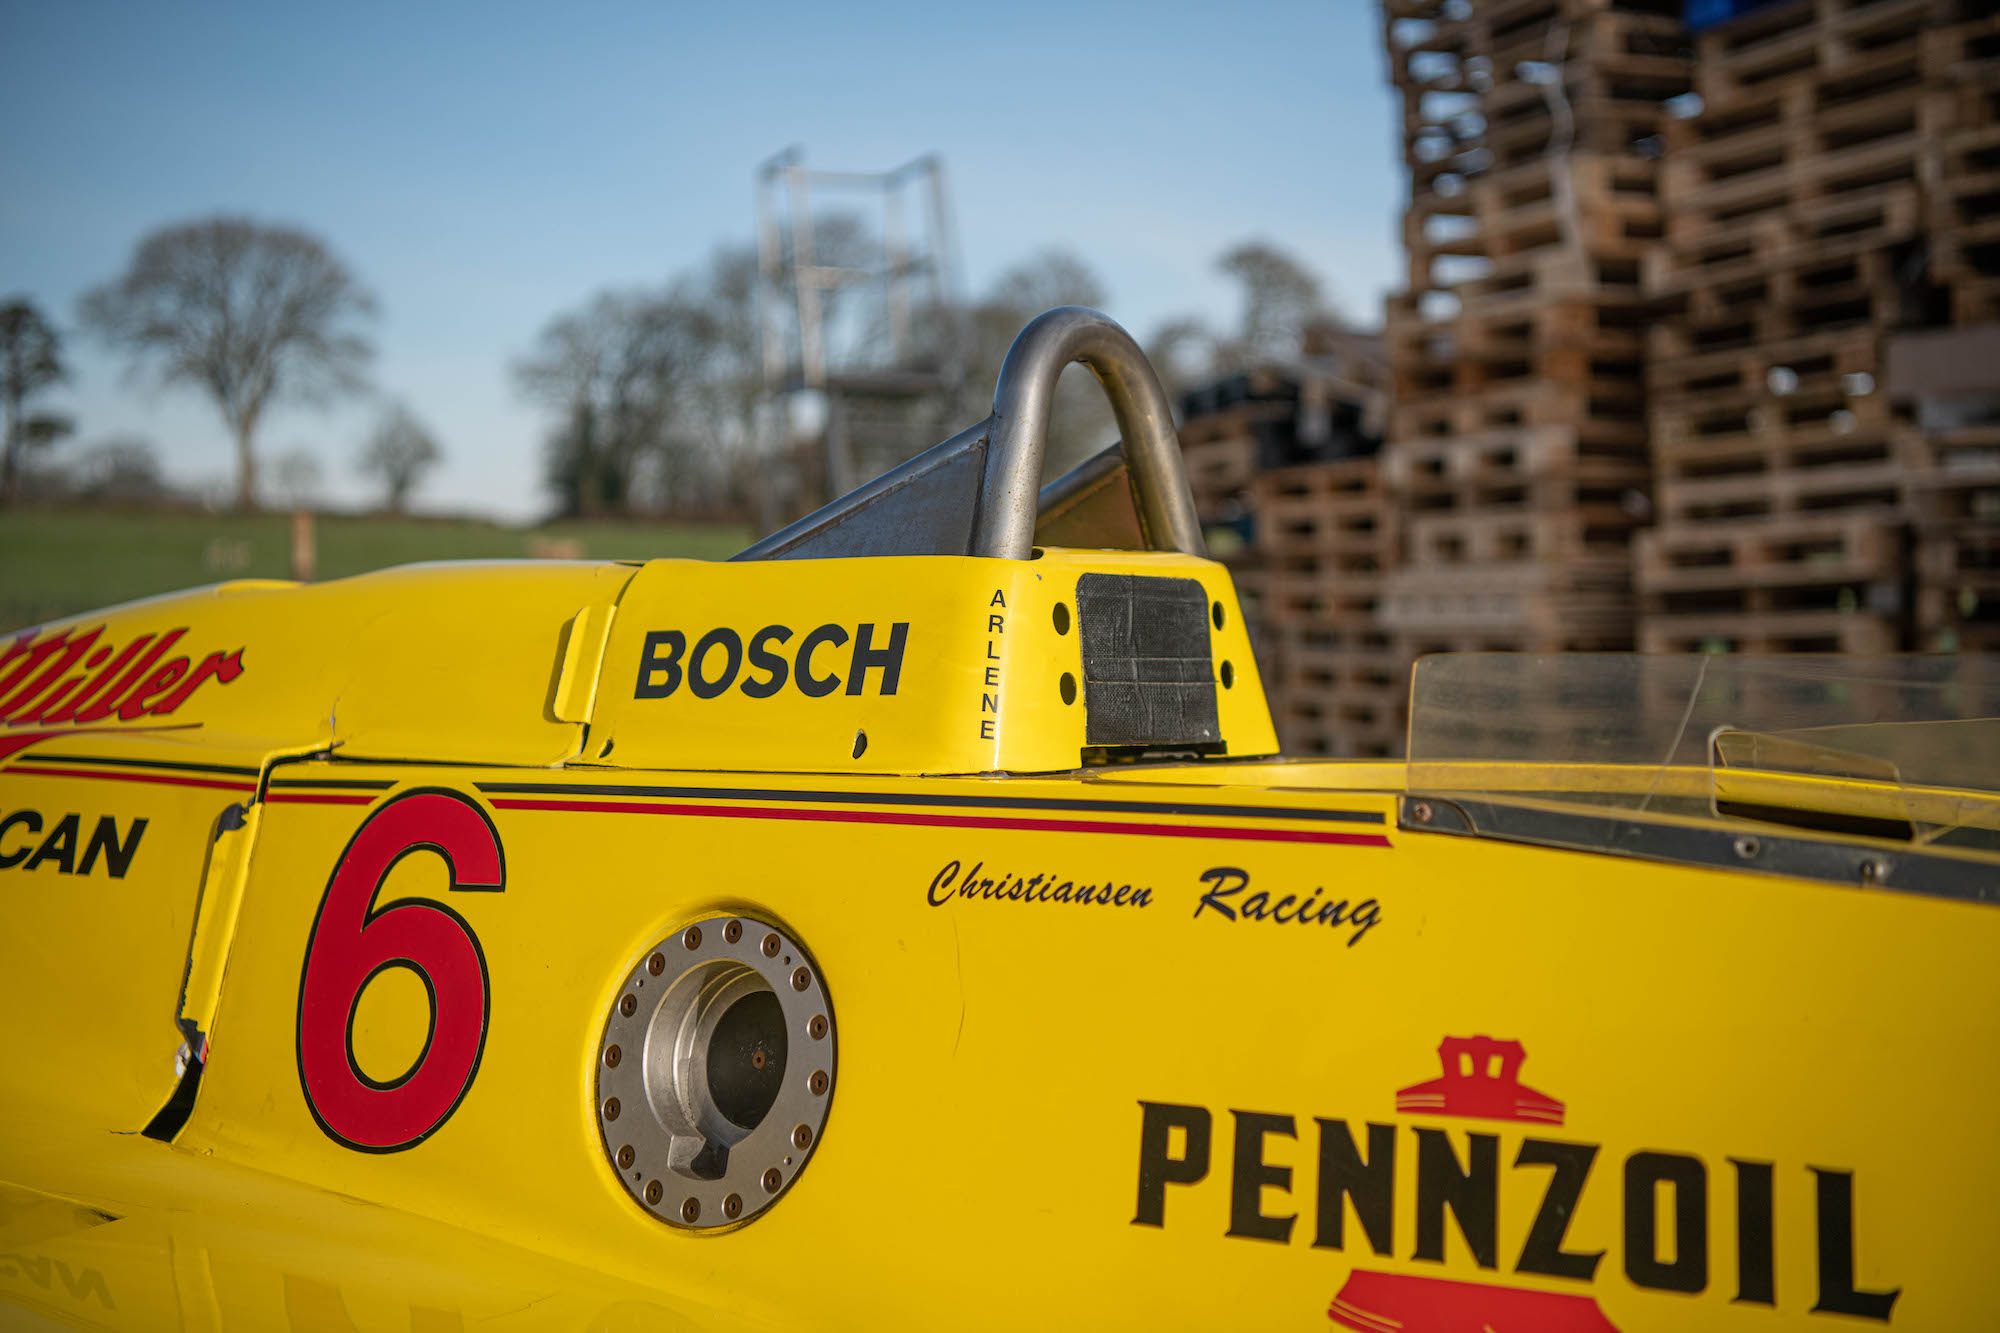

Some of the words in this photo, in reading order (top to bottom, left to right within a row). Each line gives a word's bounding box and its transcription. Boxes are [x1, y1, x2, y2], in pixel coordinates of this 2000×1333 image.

[632, 621, 911, 701] BOSCH
[979, 588, 1007, 741] ARLENE
[0, 807, 150, 881] CAN
[926, 859, 1154, 908] Christiansen
[1193, 866, 1382, 949] Racing
[295, 786, 506, 1155] 6
[1129, 1098, 1903, 1324] PENNZOIL
